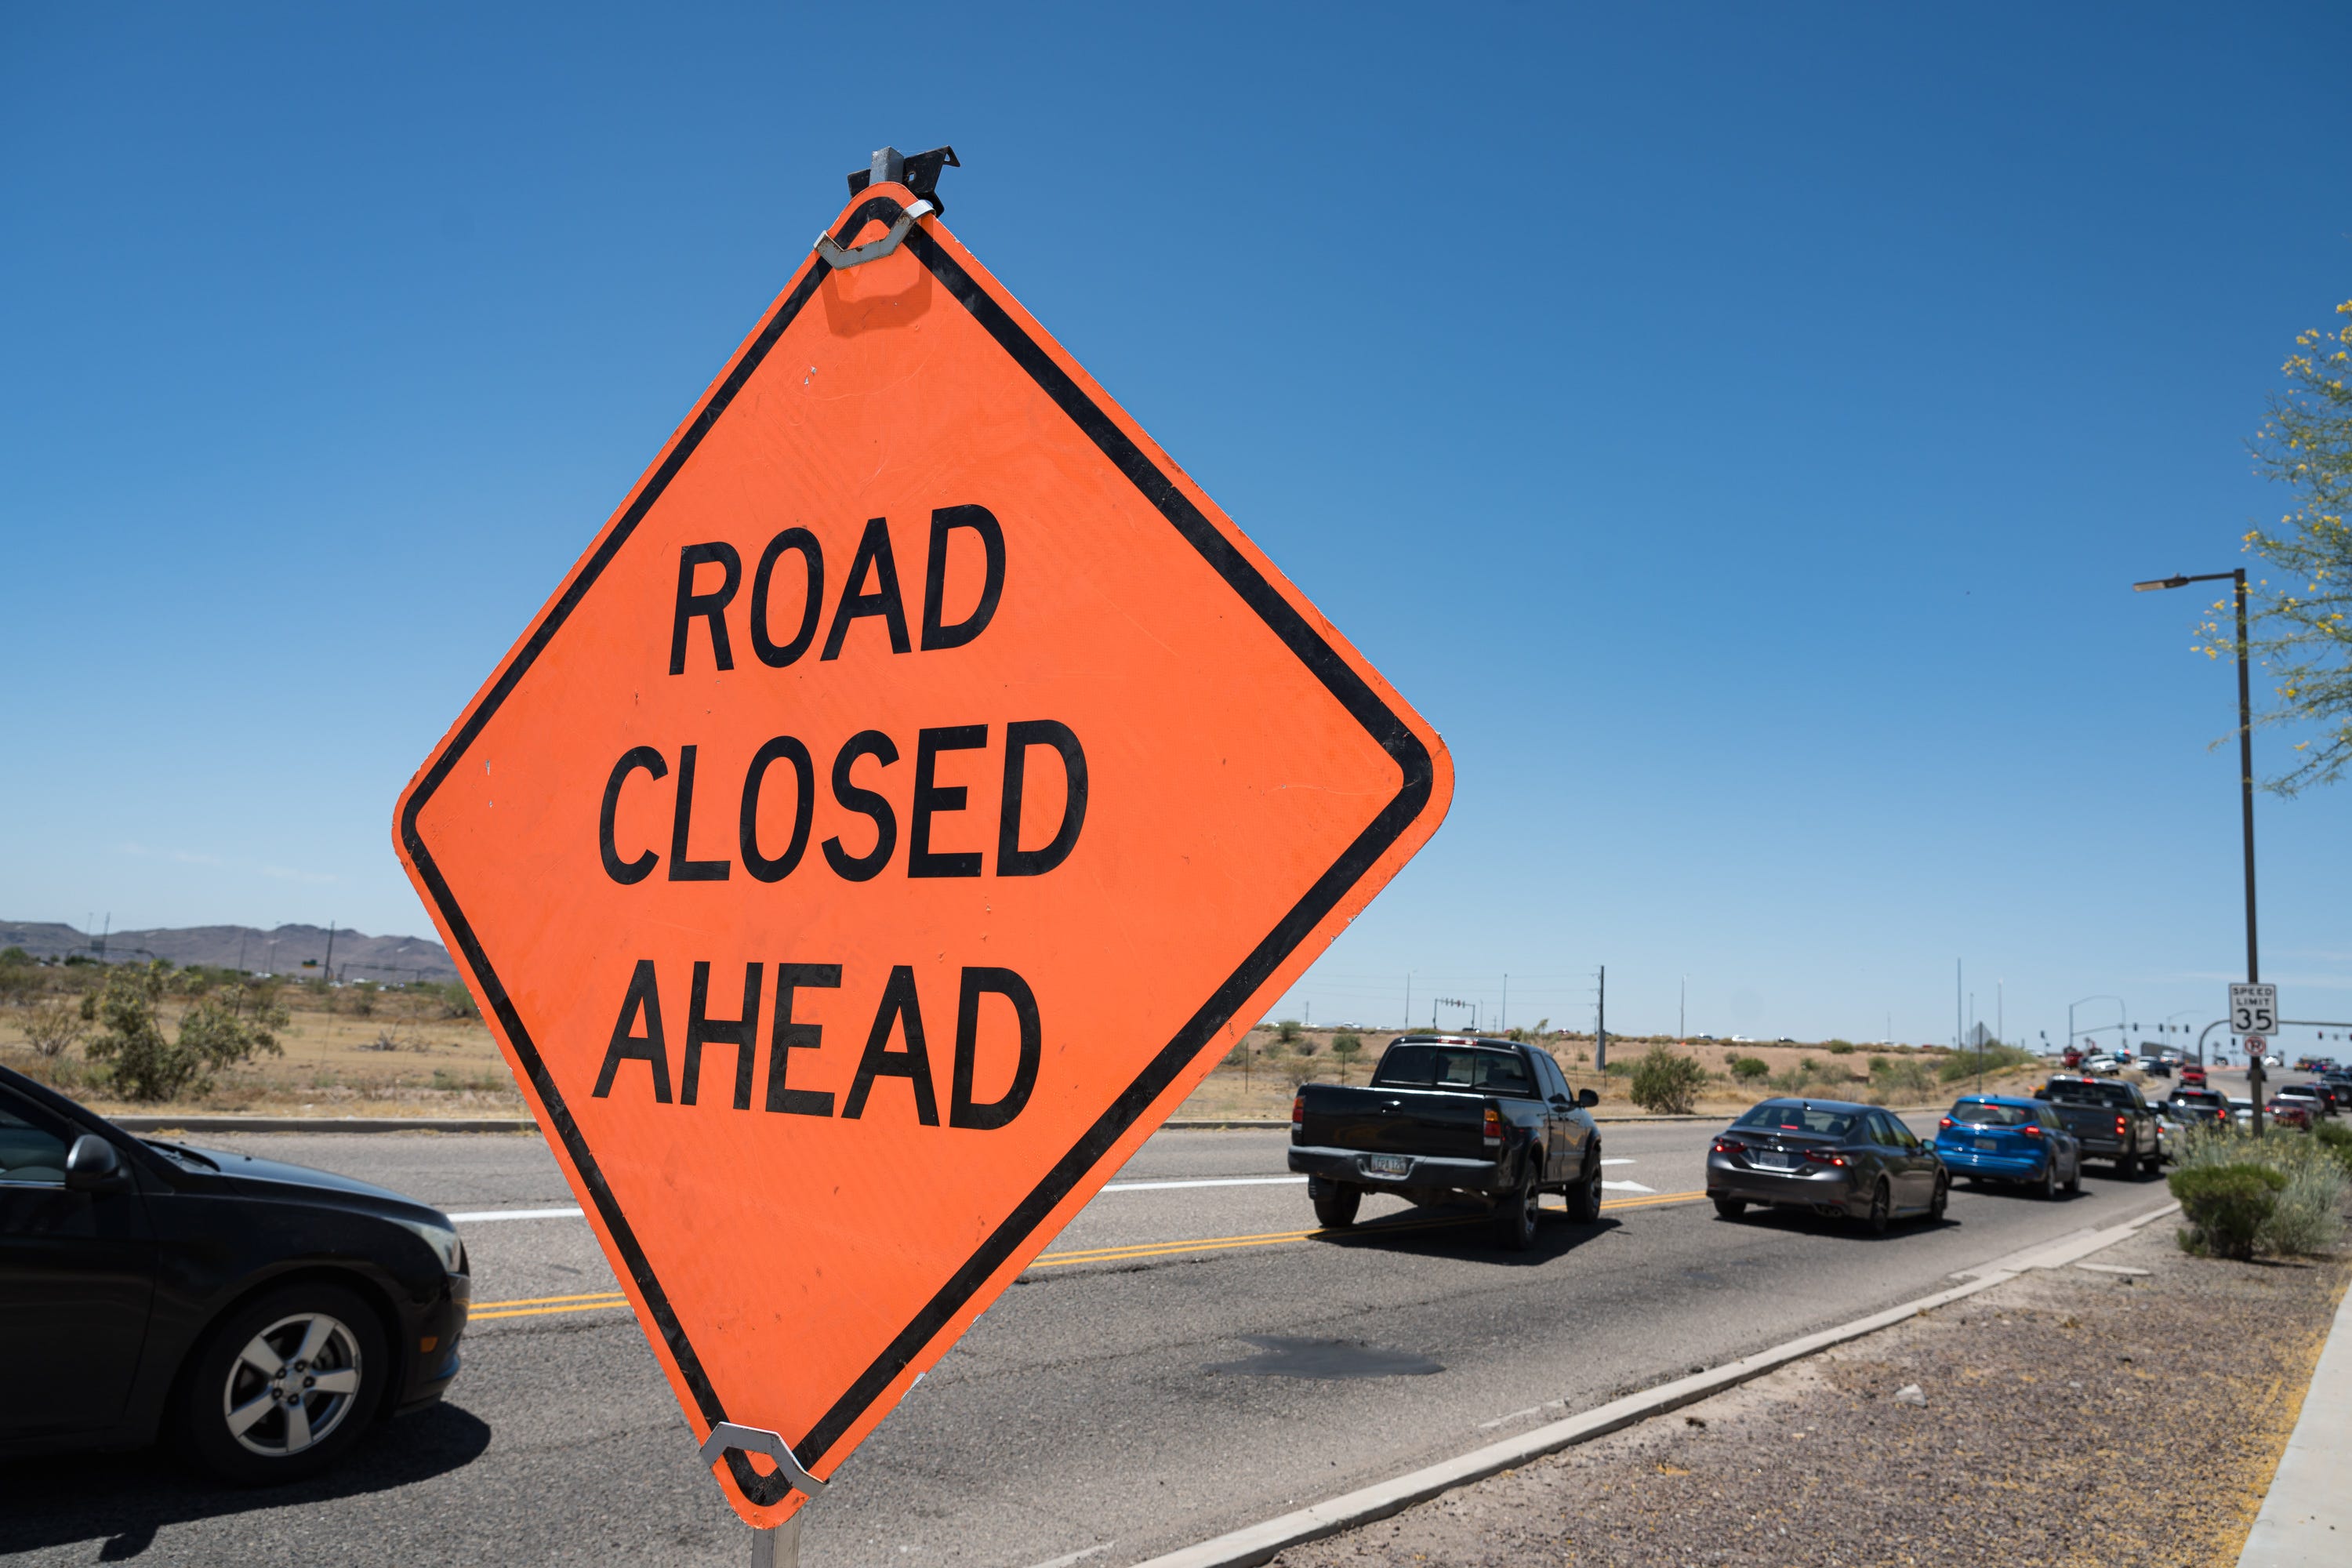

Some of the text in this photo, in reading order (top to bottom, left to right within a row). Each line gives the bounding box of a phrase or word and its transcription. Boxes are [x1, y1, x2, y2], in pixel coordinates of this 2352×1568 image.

[669, 503, 1006, 676] ROAD
[600, 720, 1088, 884] CLOSED
[593, 960, 1042, 1130] AHEAD
[2233, 987, 2272, 996] SPEED
[2236, 1008, 2272, 1030] 35
